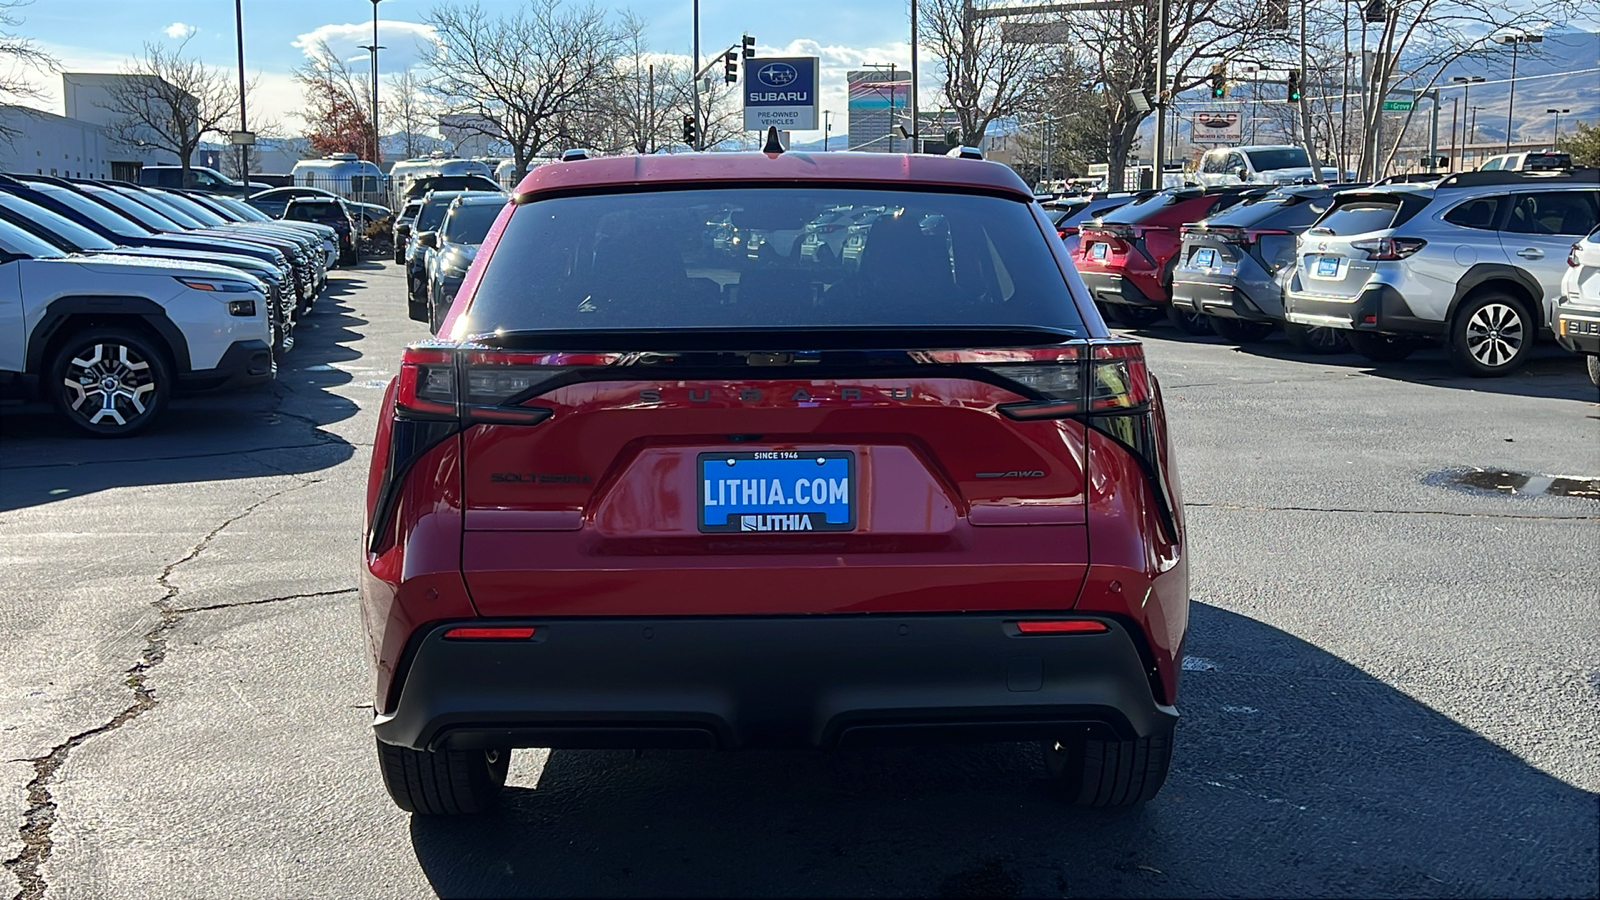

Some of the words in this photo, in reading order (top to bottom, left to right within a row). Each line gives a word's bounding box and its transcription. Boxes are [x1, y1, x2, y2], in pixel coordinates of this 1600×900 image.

[750, 91, 807, 102] SUBARU
[1569, 321, 1600, 336] SUB
[639, 387, 912, 402] SUBARU
[754, 452, 779, 460] SINCE
[780, 451, 799, 459] 1946
[704, 478, 849, 506] LITHIA.COM
[757, 514, 813, 531] LITHIA
